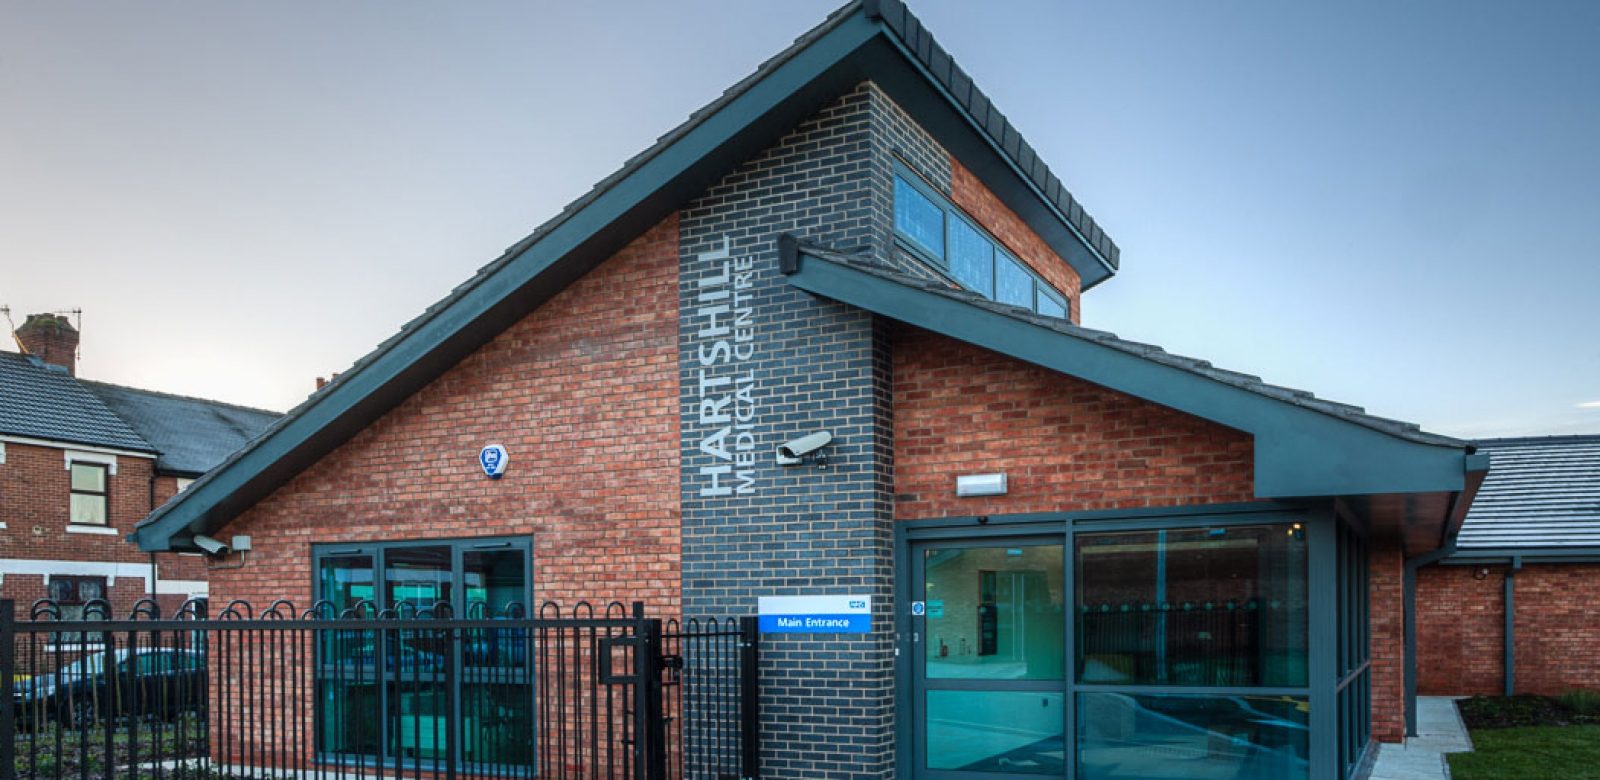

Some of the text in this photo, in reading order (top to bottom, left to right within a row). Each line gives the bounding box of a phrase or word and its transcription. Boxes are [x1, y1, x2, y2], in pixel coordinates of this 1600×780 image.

[699, 235, 732, 497] HARTSHILL
[734, 255, 756, 494] MEDICAL CENTRE
[777, 617, 850, 628] Main Entrance
